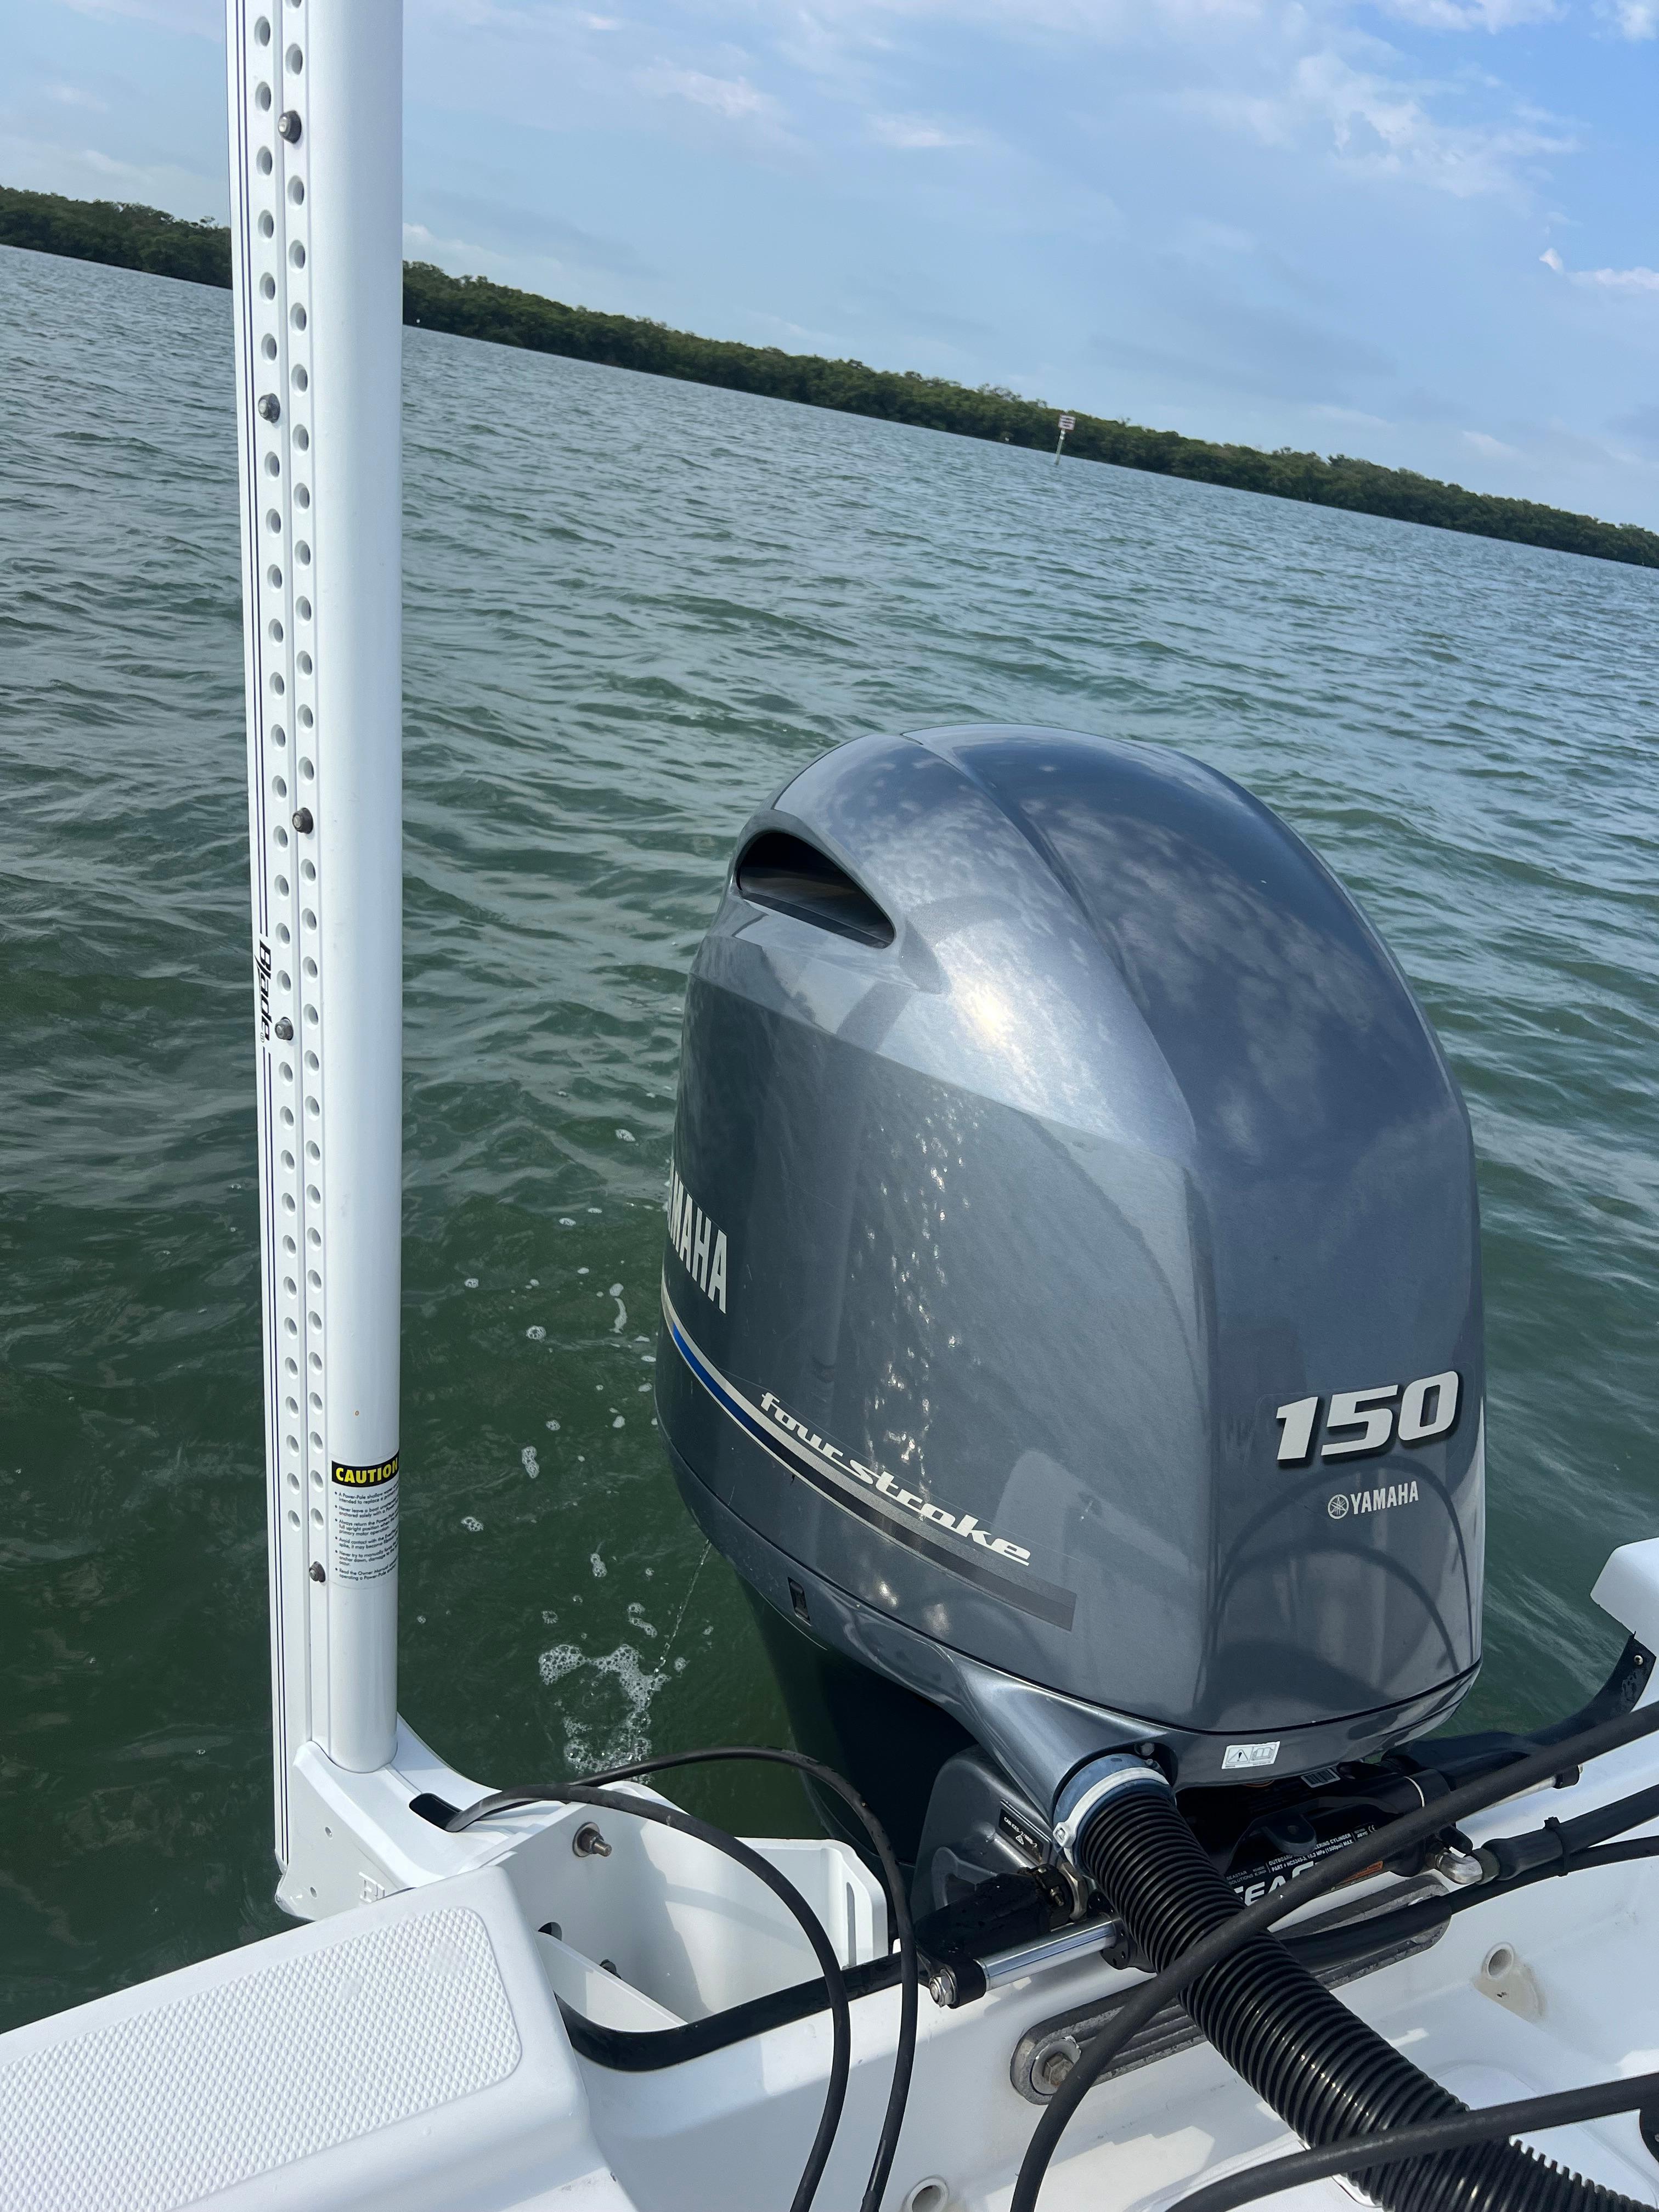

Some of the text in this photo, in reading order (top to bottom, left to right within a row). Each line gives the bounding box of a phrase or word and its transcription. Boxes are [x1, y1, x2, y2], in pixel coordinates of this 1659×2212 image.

[667, 1159, 727, 1314] MAHA
[1276, 1370, 1459, 1460] 150
[336, 1457, 398, 1484] CAUTION
[1351, 1481, 1419, 1515] YAMAHA
